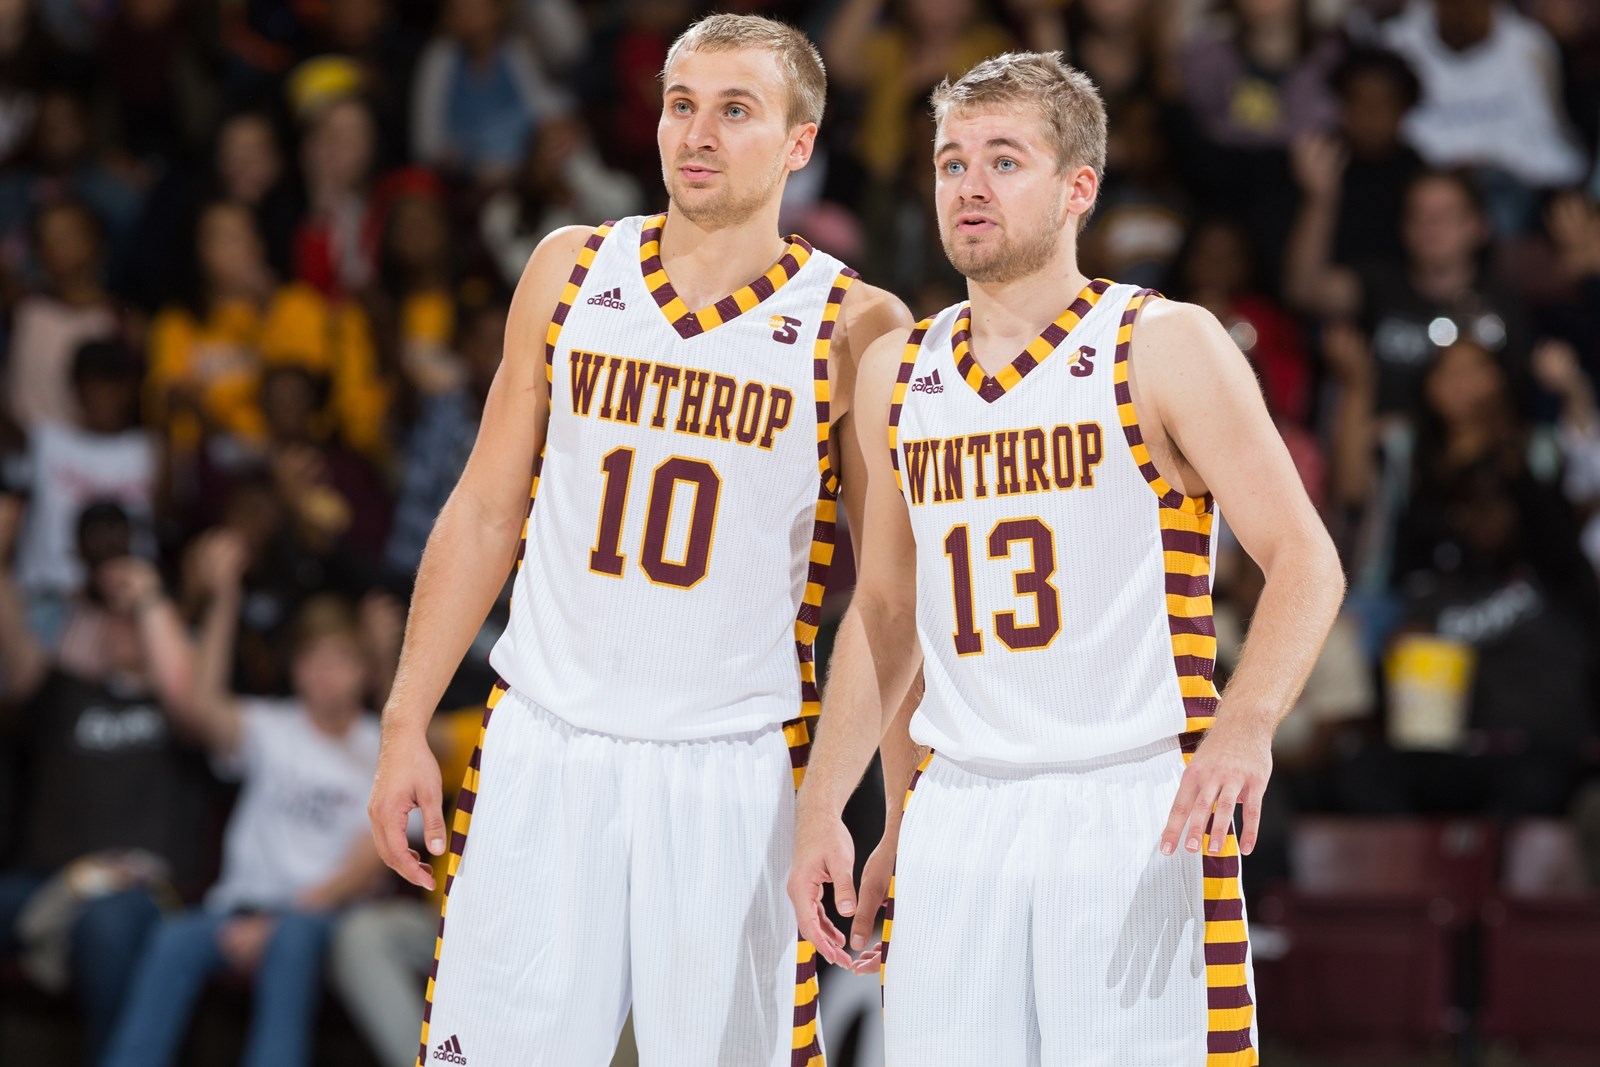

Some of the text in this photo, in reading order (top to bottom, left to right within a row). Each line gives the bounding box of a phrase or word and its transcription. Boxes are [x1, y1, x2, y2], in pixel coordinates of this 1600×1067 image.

[587, 296, 626, 311] adidas
[570, 349, 795, 451] WINTHROP
[911, 383, 944, 395] adidas
[903, 421, 1104, 506] WINTHROP
[588, 445, 724, 591] 10
[943, 516, 1063, 658] 13
[433, 1050, 467, 1066] adidas
